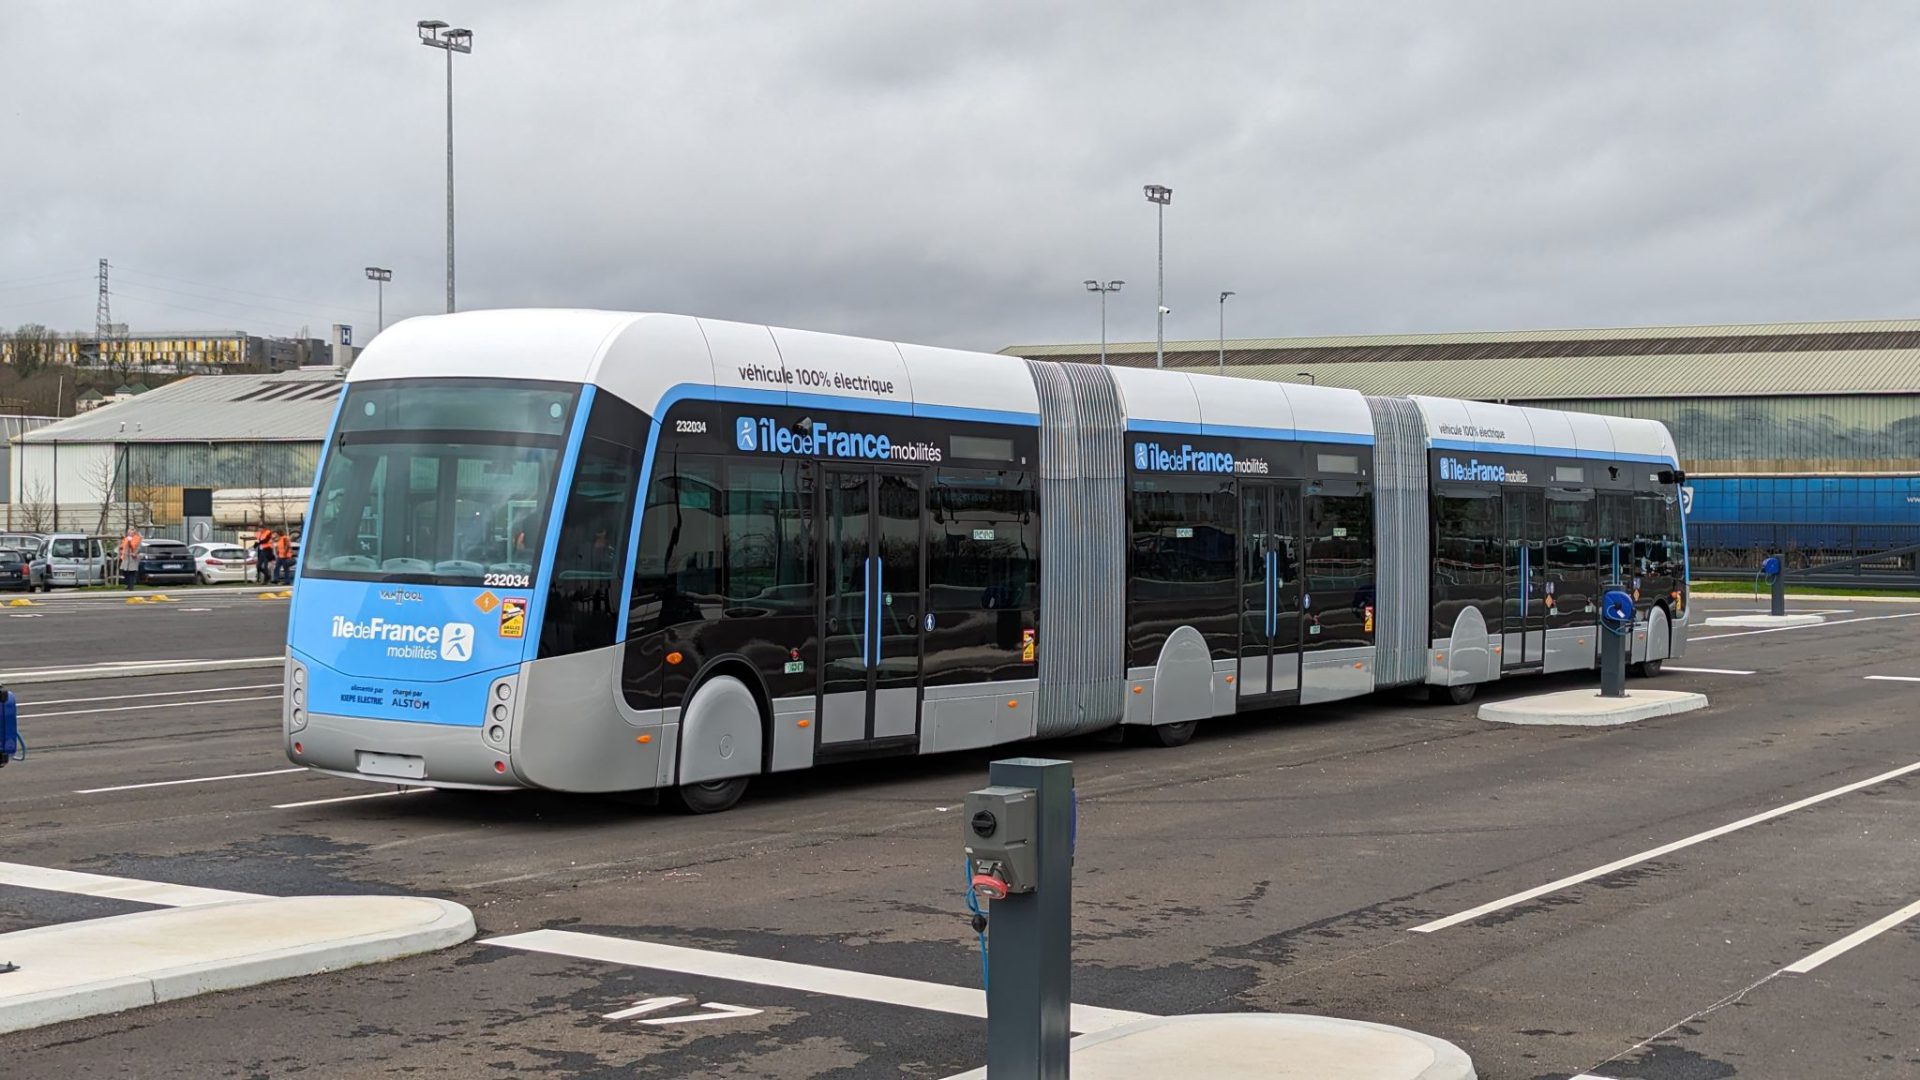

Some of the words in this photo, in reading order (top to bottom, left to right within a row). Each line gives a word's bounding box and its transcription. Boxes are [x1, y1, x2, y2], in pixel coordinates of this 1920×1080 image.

[342, 329, 351, 344] H
[738, 363, 794, 384] véhicule
[795, 369, 832, 388] 100%
[833, 372, 894, 395] électrique
[676, 420, 707, 433] 232034
[1439, 423, 1462, 435] véhicule
[1479, 427, 1506, 440] électrique
[890, 442, 942, 462] mobilités
[1234, 457, 1269, 474] mobilités
[1505, 469, 1529, 483] mobilités
[484, 573, 530, 588] 232034
[387, 645, 438, 660] mobilités
[357, 695, 384, 705] ELECTRIC
[391, 698, 430, 709] ALSTOM
